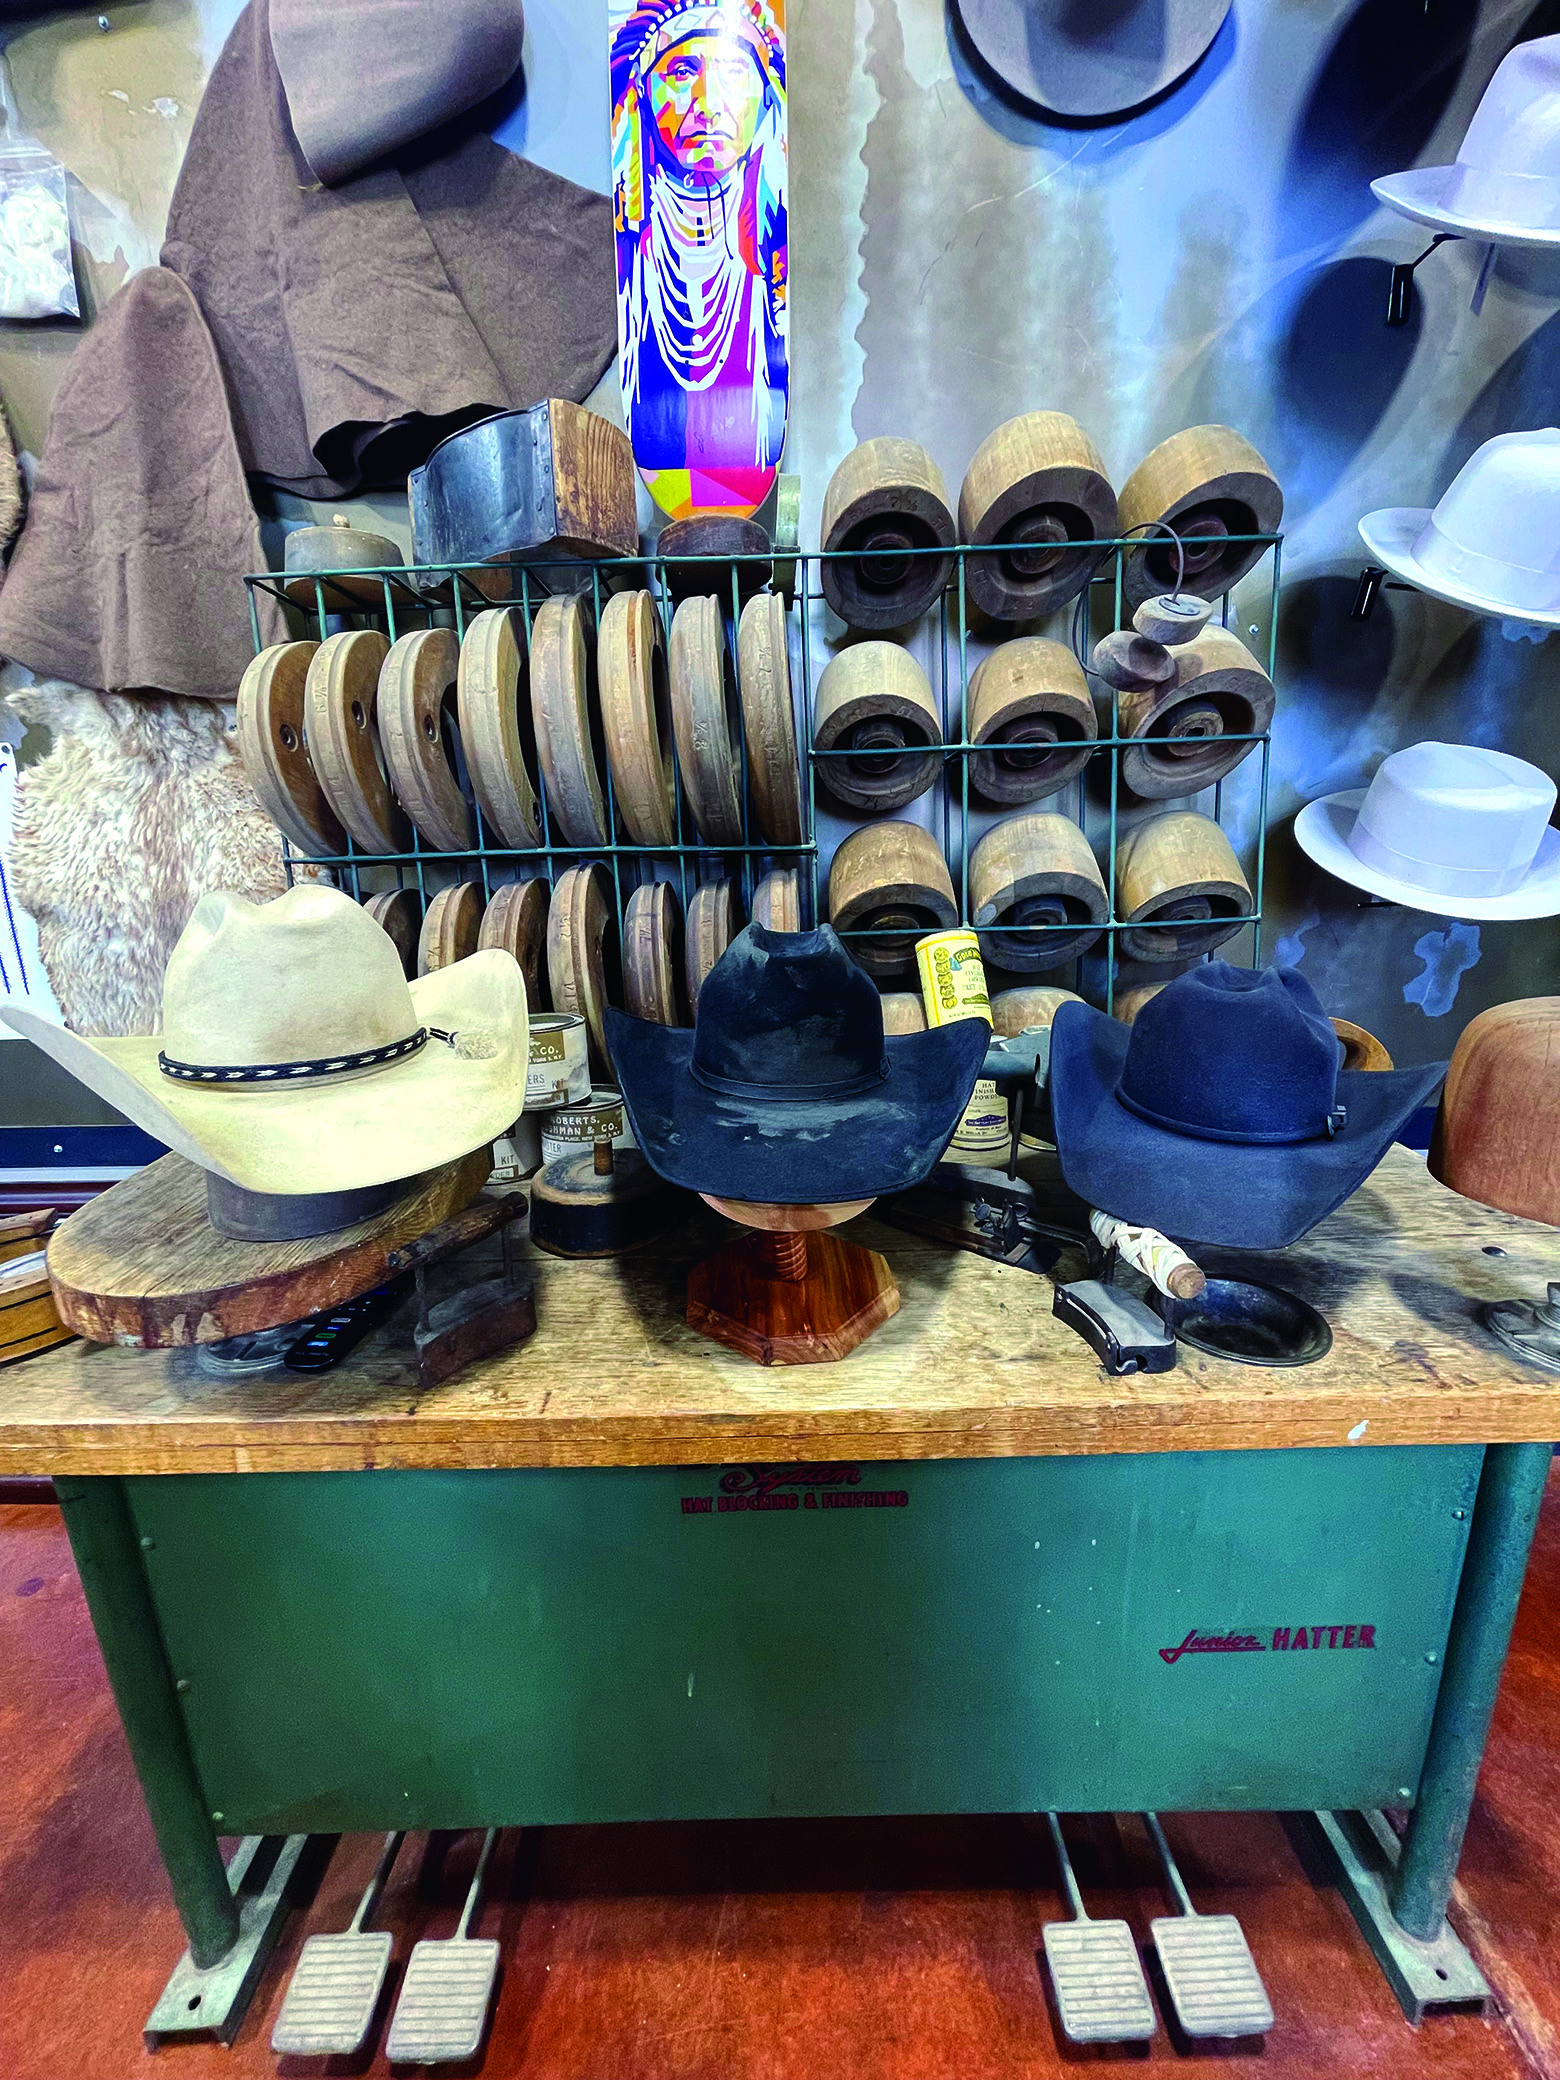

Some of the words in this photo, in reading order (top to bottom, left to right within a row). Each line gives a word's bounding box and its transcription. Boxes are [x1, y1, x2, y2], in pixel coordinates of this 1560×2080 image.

[539, 1045, 559, 1056] CO.
[586, 1125, 595, 1135] &
[601, 1122, 618, 1132] CO.
[500, 1154, 515, 1165] KIT
[681, 1496, 714, 1514] HAT
[717, 1493, 799, 1512] BLOCKING
[803, 1492, 819, 1510] &
[821, 1490, 909, 1509] FINISHING
[1271, 1624, 1377, 1651] HATTER
